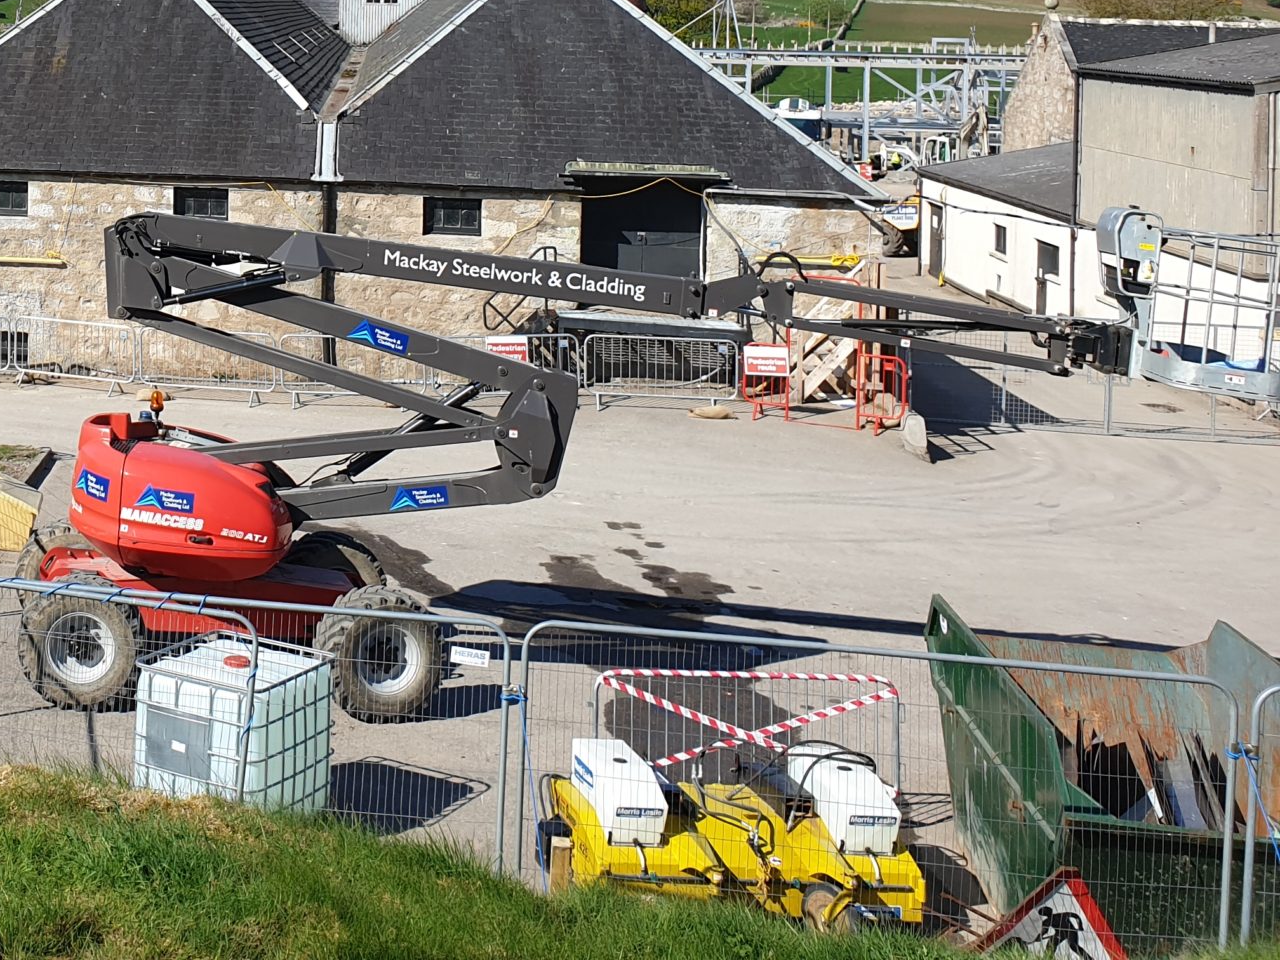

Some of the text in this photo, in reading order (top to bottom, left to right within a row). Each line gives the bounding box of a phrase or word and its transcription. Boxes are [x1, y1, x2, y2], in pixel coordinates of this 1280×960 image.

[384, 249, 646, 301] Mackay Steelwork & Cladding
[487, 344, 526, 352] Pedestrian
[748, 358, 786, 366] Pedestrian
[120, 507, 204, 531] MANIACCESS
[243, 533, 268, 544] ATJ
[454, 650, 487, 660] HERAS
[617, 808, 663, 817] Morris Leslie
[850, 815, 896, 825] Morris Leslie
